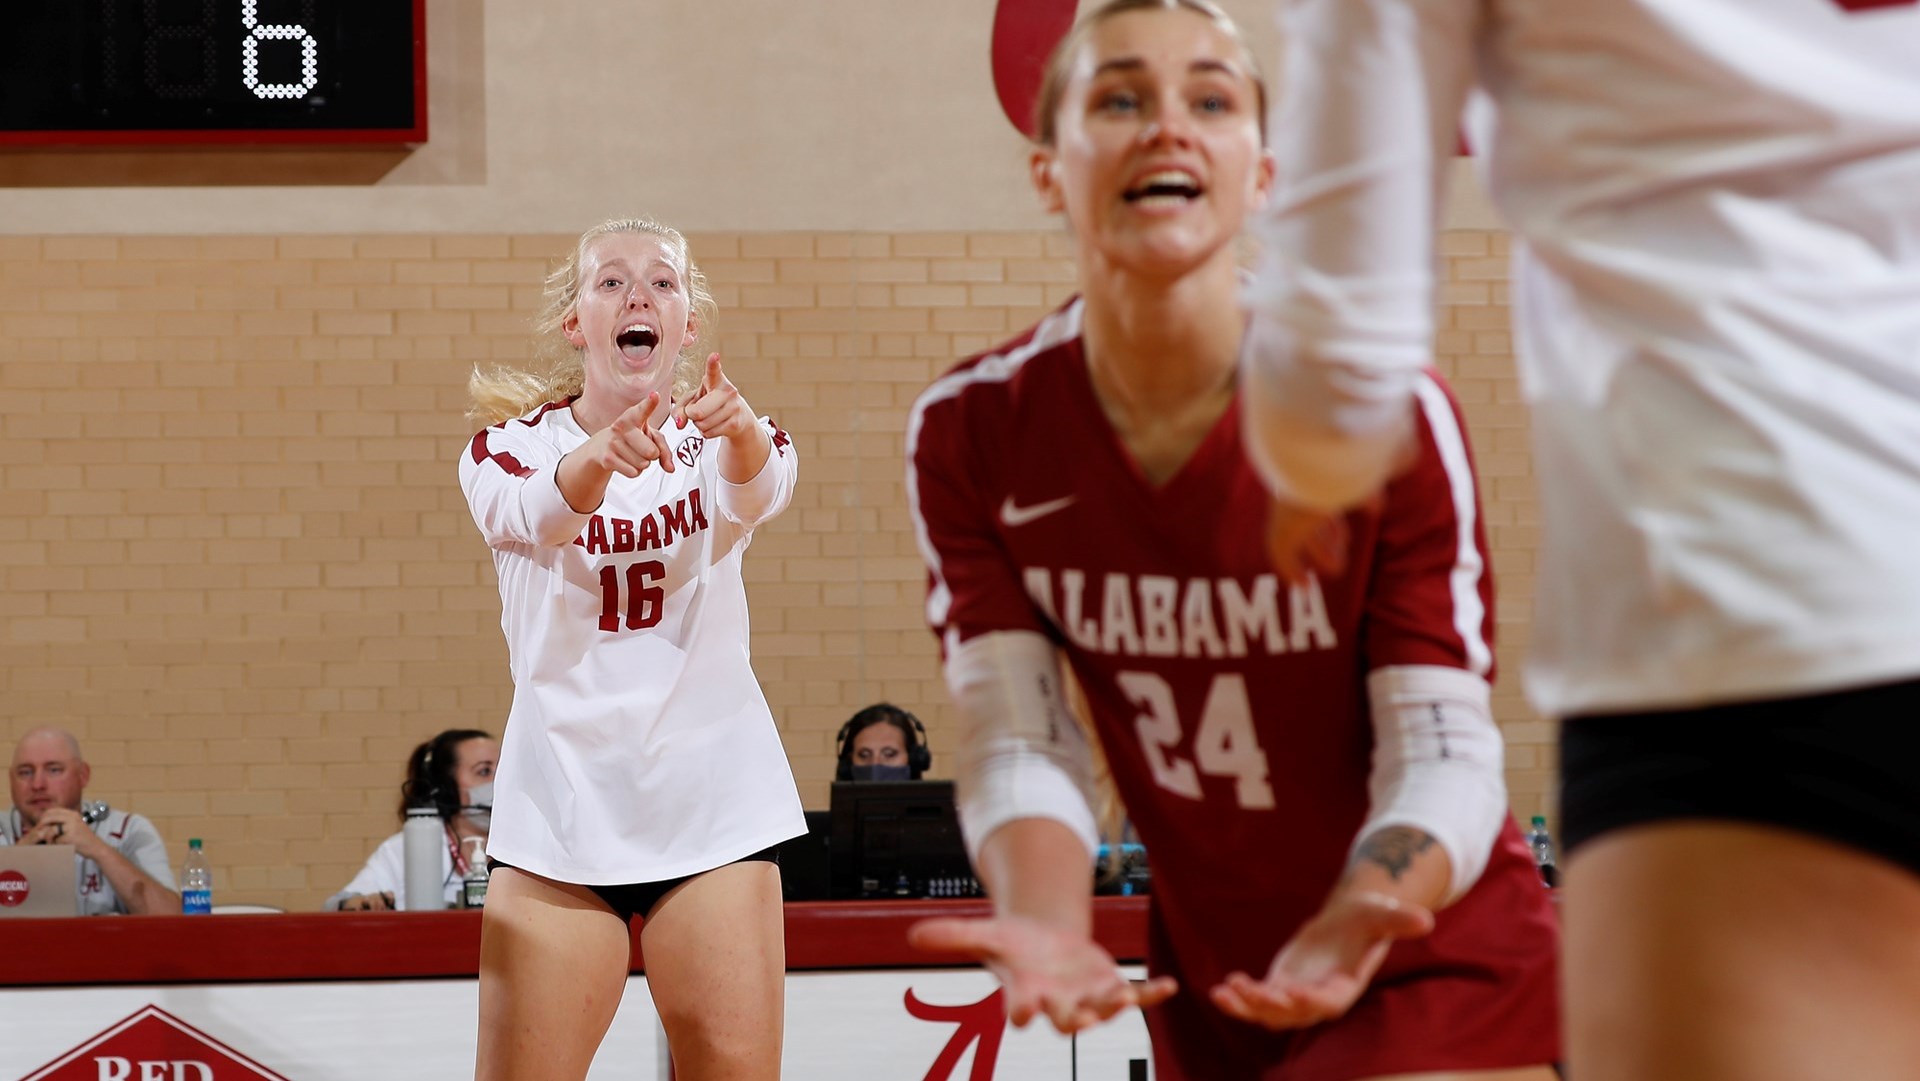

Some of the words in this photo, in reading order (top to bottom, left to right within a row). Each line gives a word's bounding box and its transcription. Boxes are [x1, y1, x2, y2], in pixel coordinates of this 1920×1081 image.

[242, 0, 317, 98] 6
[573, 487, 709, 555] ABAMA
[598, 560, 666, 632] 16
[1115, 669, 1276, 810] 24
